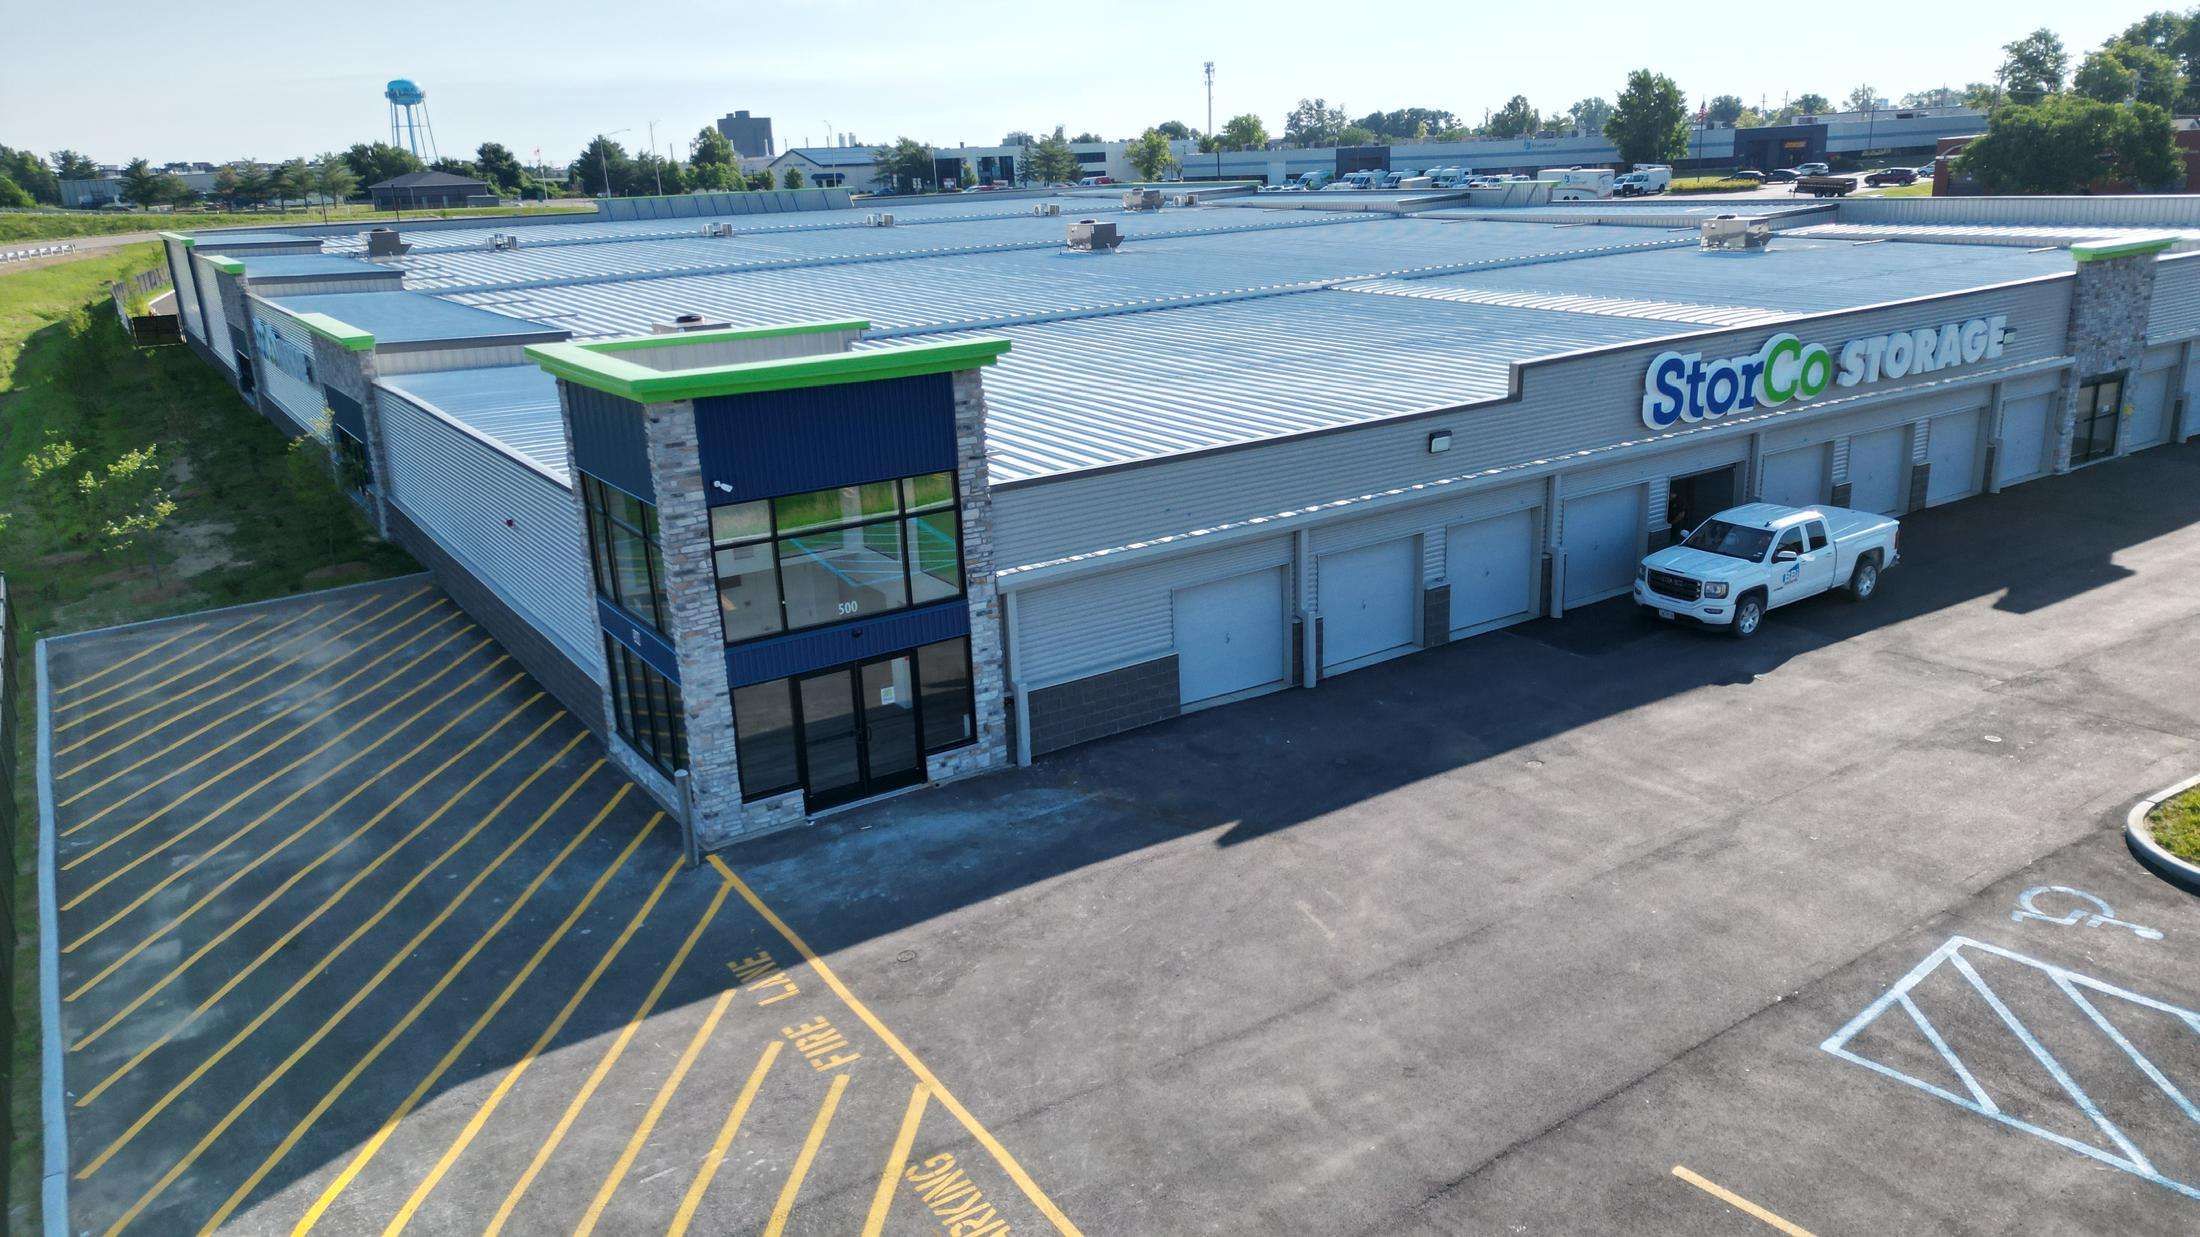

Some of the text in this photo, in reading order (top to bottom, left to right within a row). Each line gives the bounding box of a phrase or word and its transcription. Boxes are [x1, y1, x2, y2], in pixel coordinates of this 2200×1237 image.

[1650, 315, 2007, 427] StorCo STORAGE
[838, 600, 858, 615] 500
[726, 951, 801, 1007] LANE
[781, 1015, 862, 1072] FIRE
